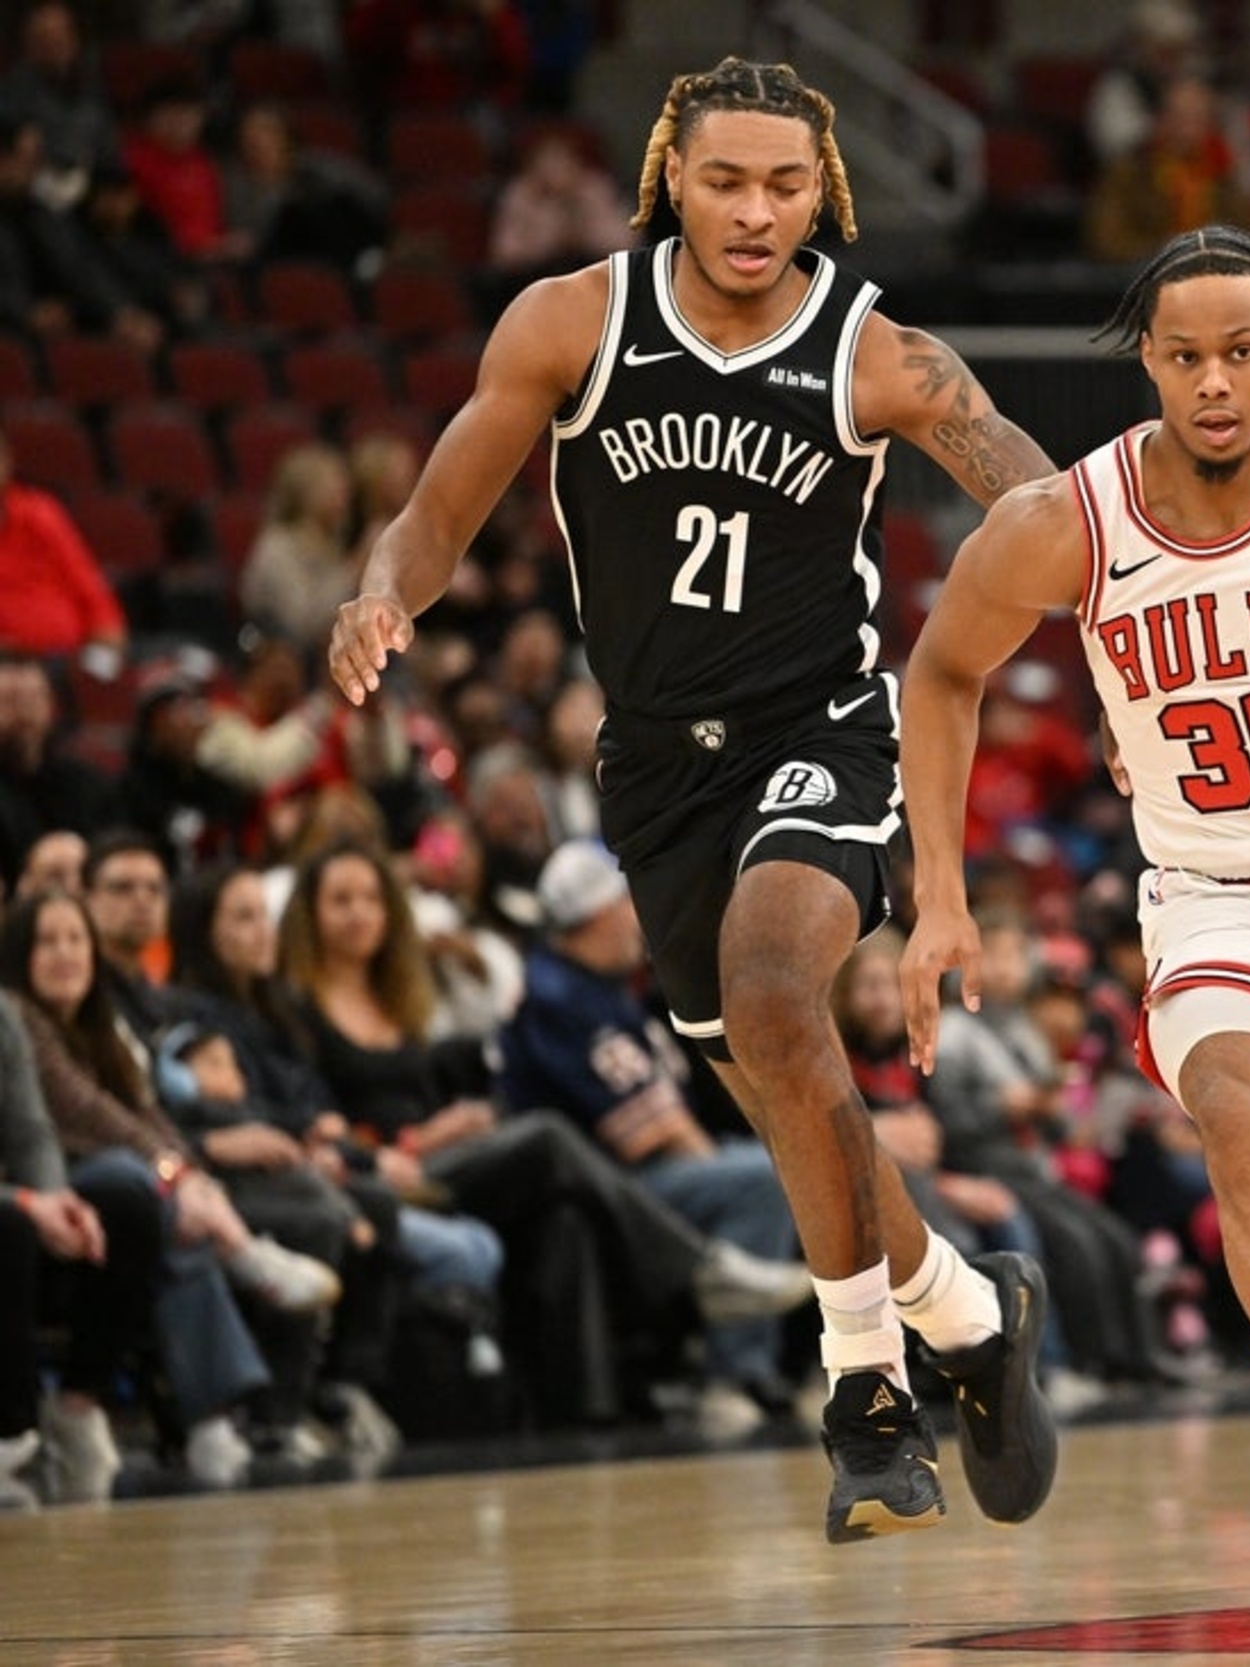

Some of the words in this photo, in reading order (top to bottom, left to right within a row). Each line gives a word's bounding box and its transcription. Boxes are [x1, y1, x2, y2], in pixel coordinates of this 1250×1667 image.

[768, 367, 786, 385] All
[599, 412, 834, 506] BROOKLYN
[670, 504, 750, 613] 21
